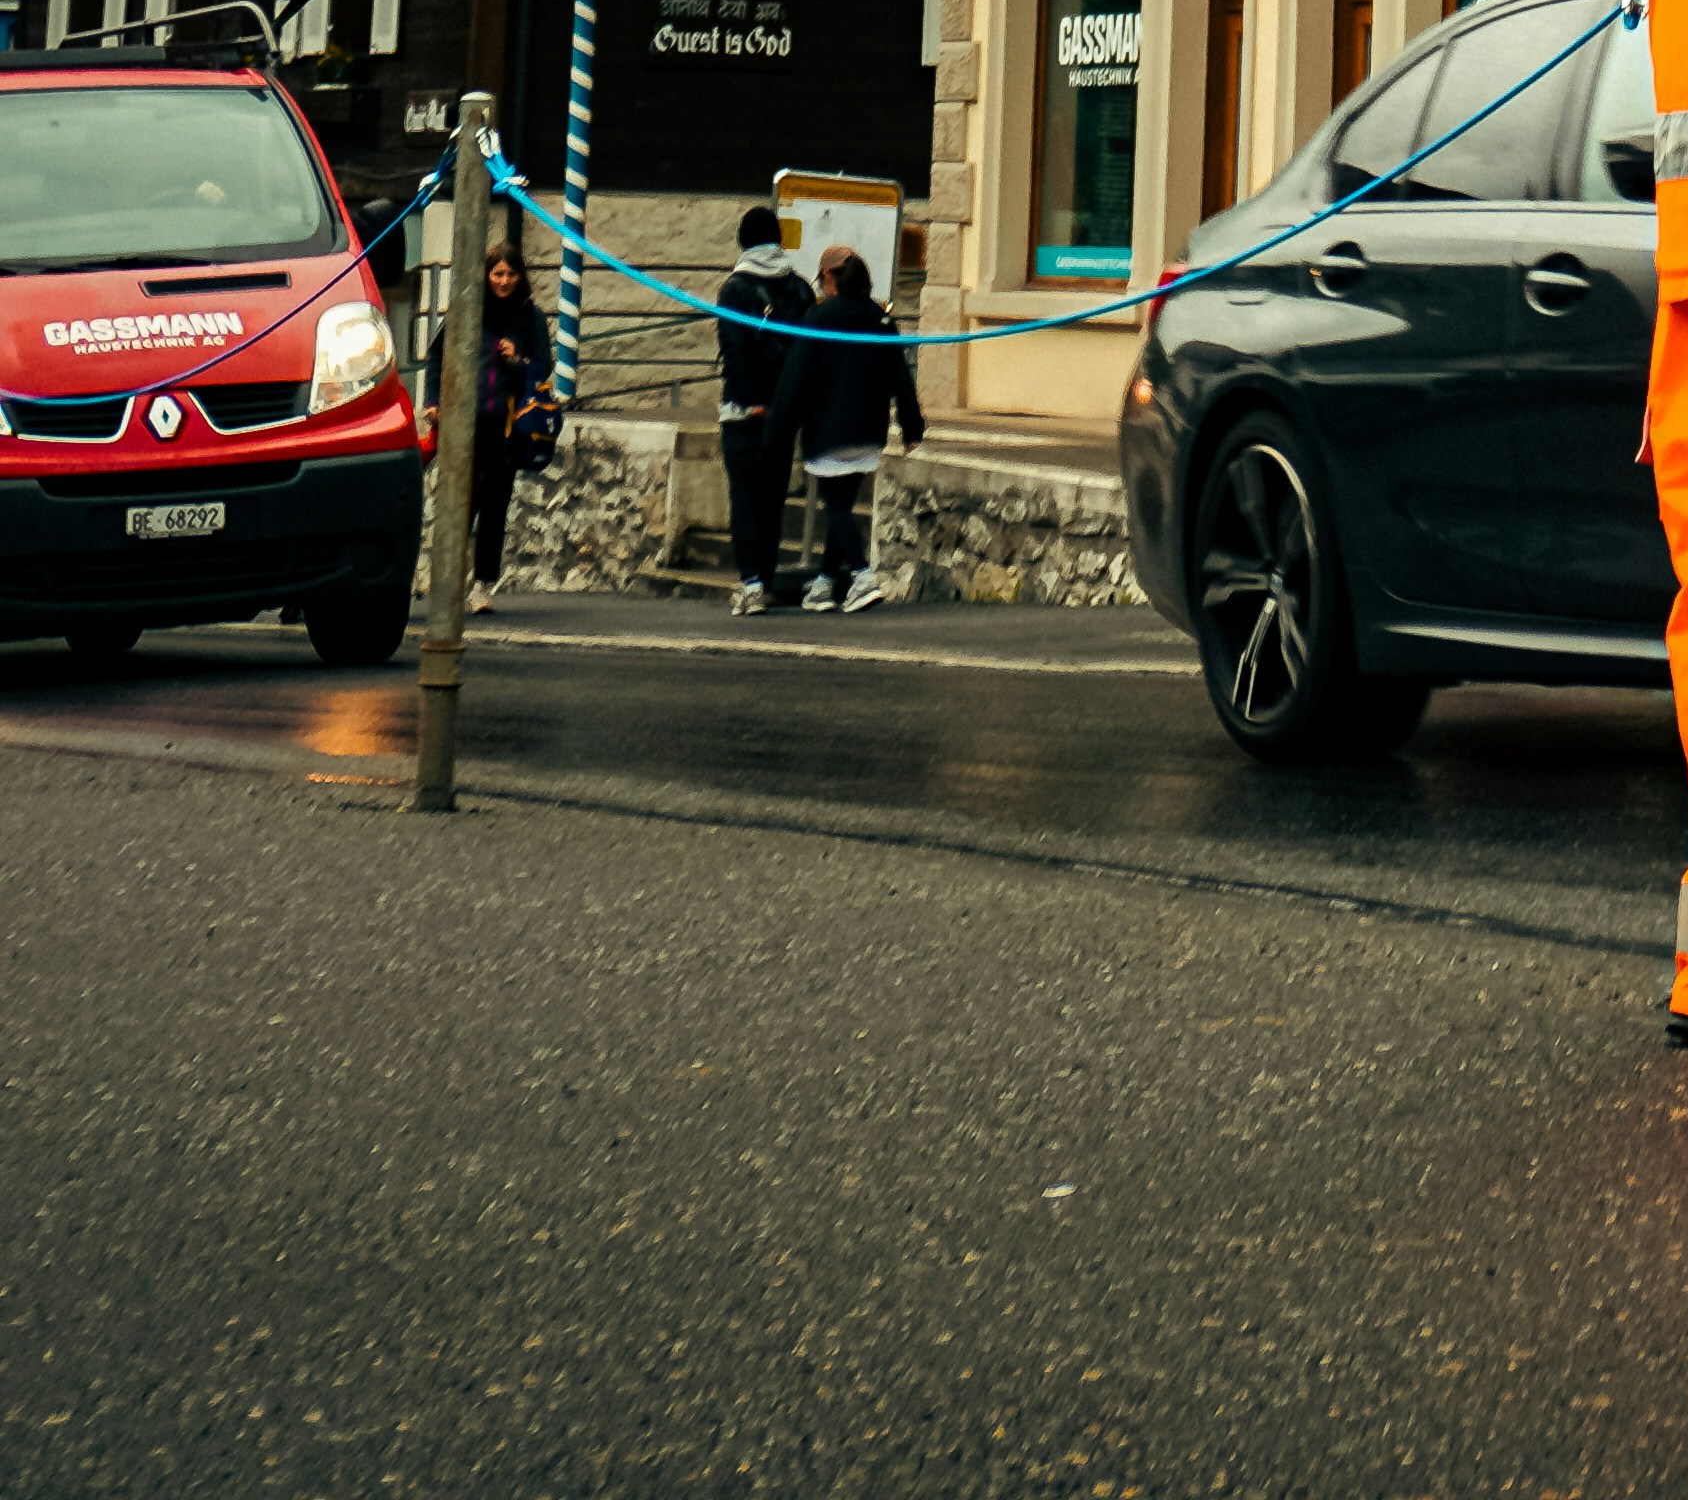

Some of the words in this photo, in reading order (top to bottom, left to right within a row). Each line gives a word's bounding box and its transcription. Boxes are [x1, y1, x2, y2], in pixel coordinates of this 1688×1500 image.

[653, 24, 721, 54] Guest
[724, 28, 743, 55] is
[745, 26, 792, 57] God
[1068, 67, 1133, 88] HAUSTECHNIK
[43, 312, 244, 347] GASSMANN
[73, 336, 197, 356] HAUSTECHNIK
[202, 336, 226, 347] AG
[164, 507, 219, 531] 68292
